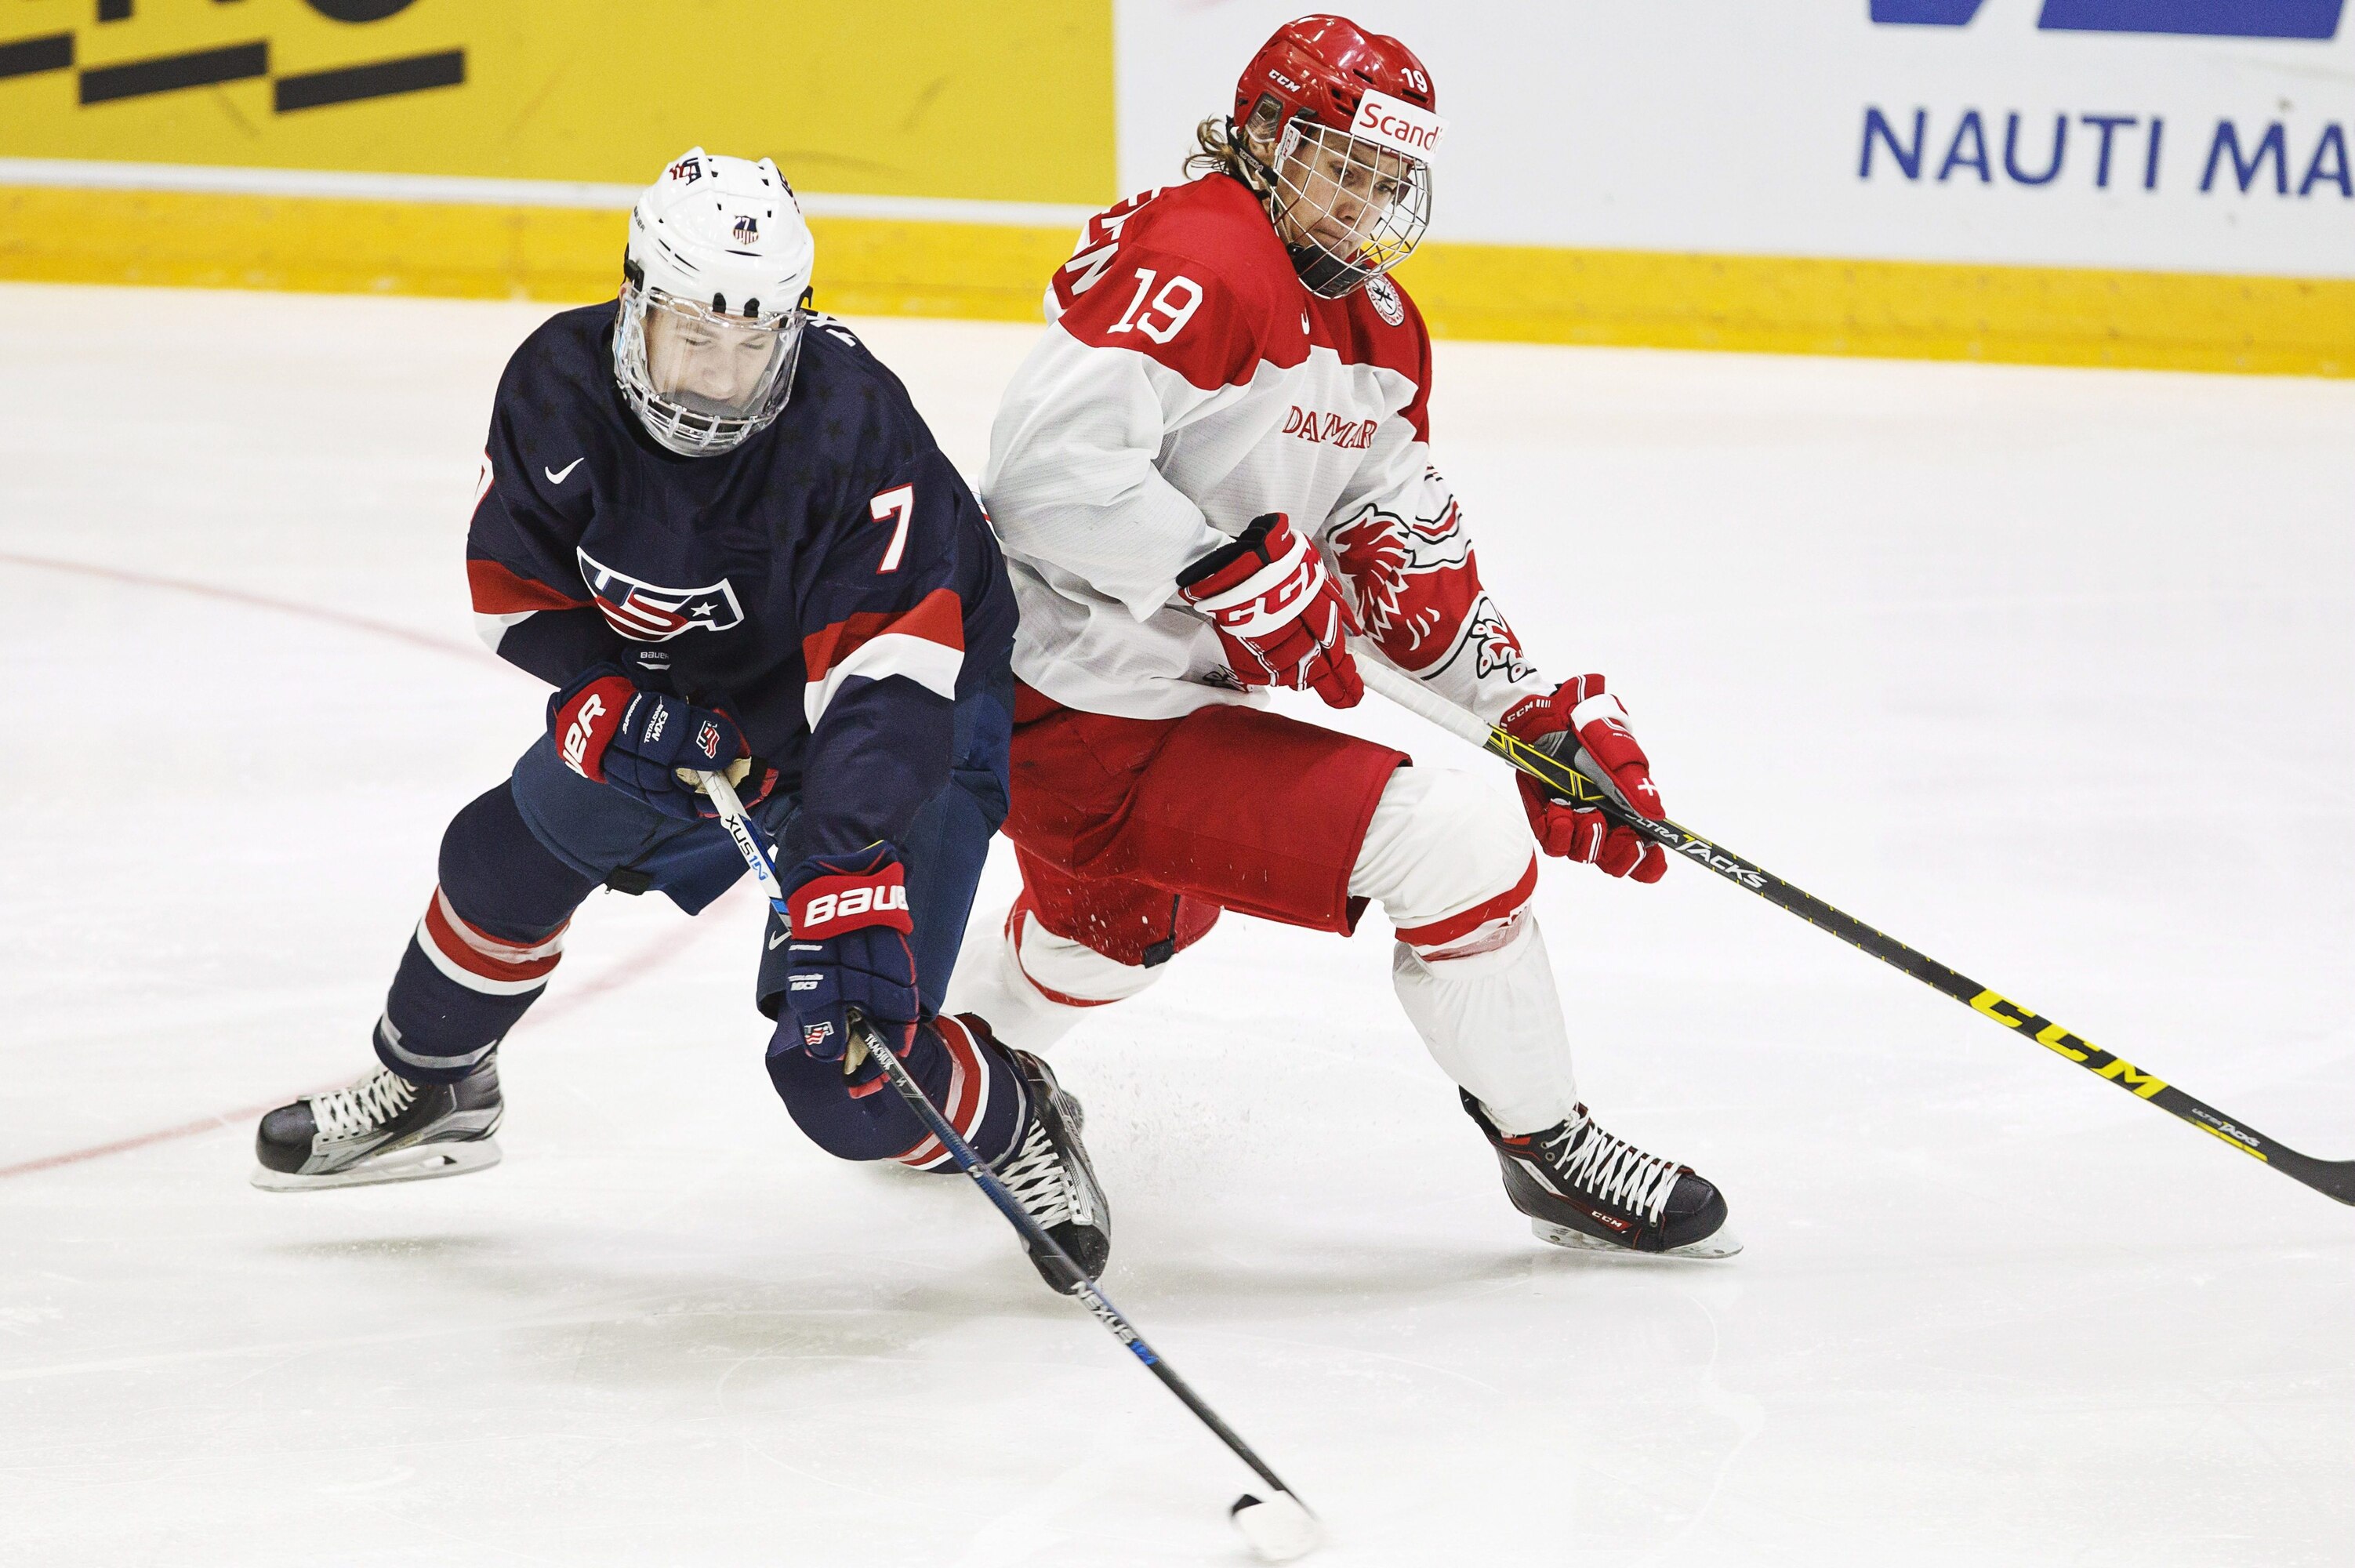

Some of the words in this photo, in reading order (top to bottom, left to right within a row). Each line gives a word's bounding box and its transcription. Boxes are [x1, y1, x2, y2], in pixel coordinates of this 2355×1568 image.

[1268, 68, 1301, 93] CCM
[1401, 67, 1428, 93] 19
[1858, 105, 2164, 191] NAUTI
[2198, 117, 2355, 199] MA
[1106, 267, 1203, 345] 19
[869, 481, 914, 574] 7
[651, 710, 669, 742] MX3
[1507, 701, 1533, 722] CCM
[1675, 833, 1768, 889] TACKS
[1969, 988, 2170, 1099] CCM
[1591, 1210, 1623, 1228] CCM
[1070, 1280, 1139, 1345] NEXUS
